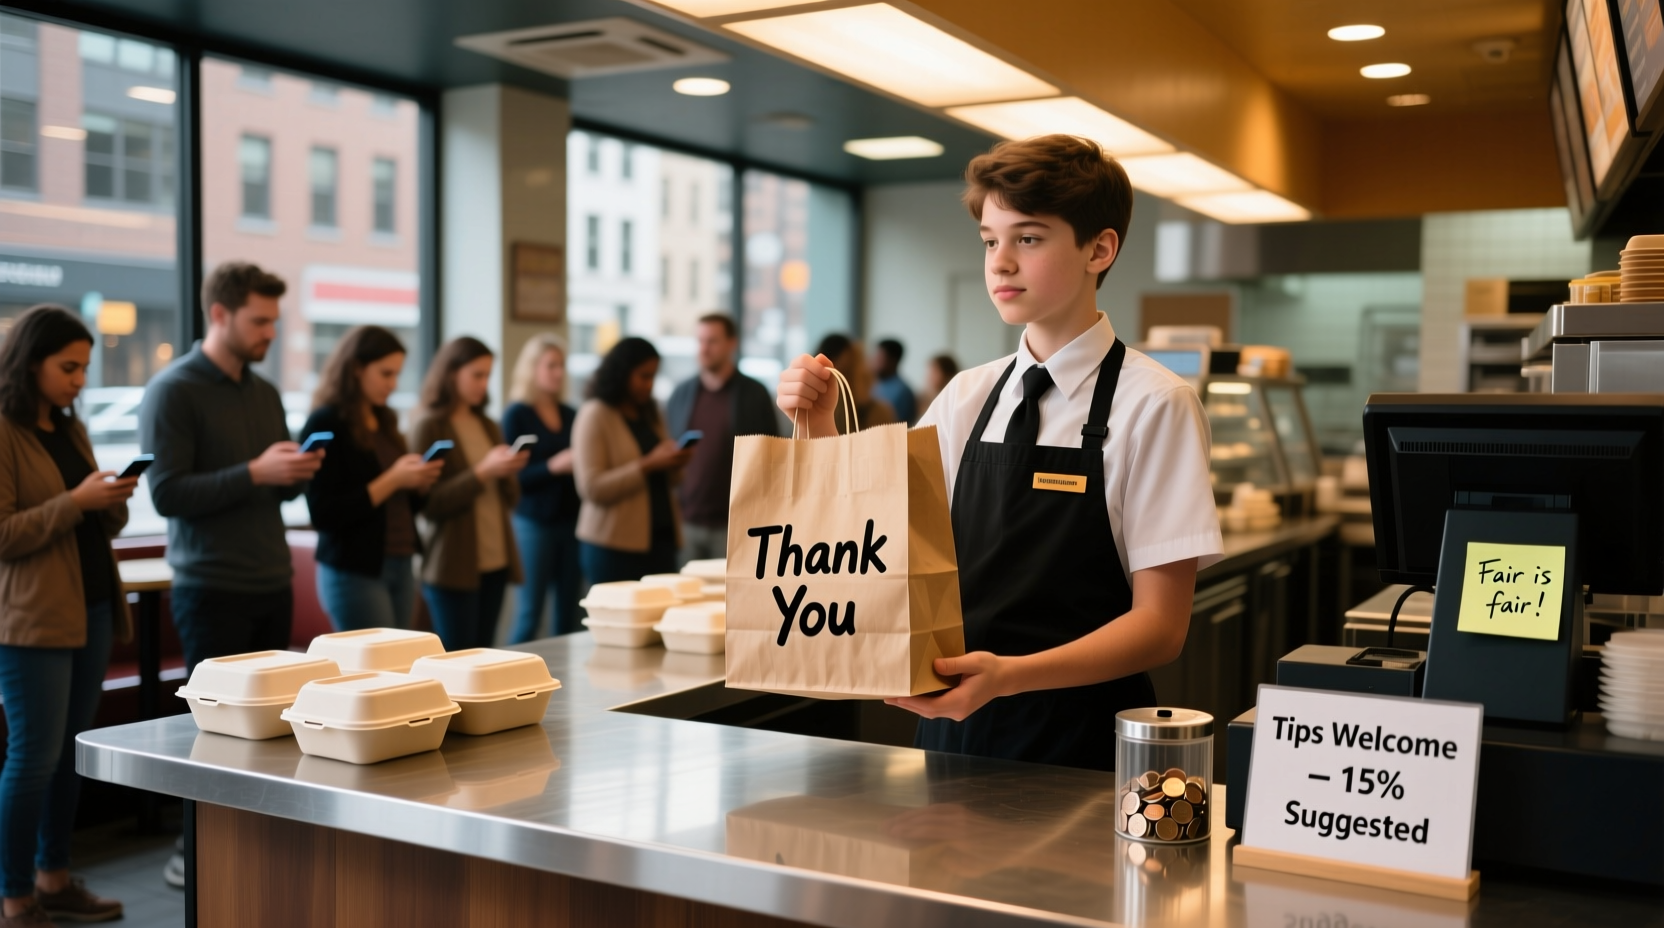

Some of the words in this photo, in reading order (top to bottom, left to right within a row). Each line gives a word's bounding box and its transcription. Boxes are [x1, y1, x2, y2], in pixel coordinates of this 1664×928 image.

[748, 519, 888, 580] Thank
[1479, 558, 1525, 584] Fair
[1534, 566, 1552, 585] is
[772, 584, 856, 647] You
[1486, 590, 1545, 620] fair!
[1273, 716, 1324, 749] Tips
[1332, 722, 1458, 760] Welcome
[1342, 766, 1405, 800] 15%
[1284, 800, 1430, 845] Suggested
